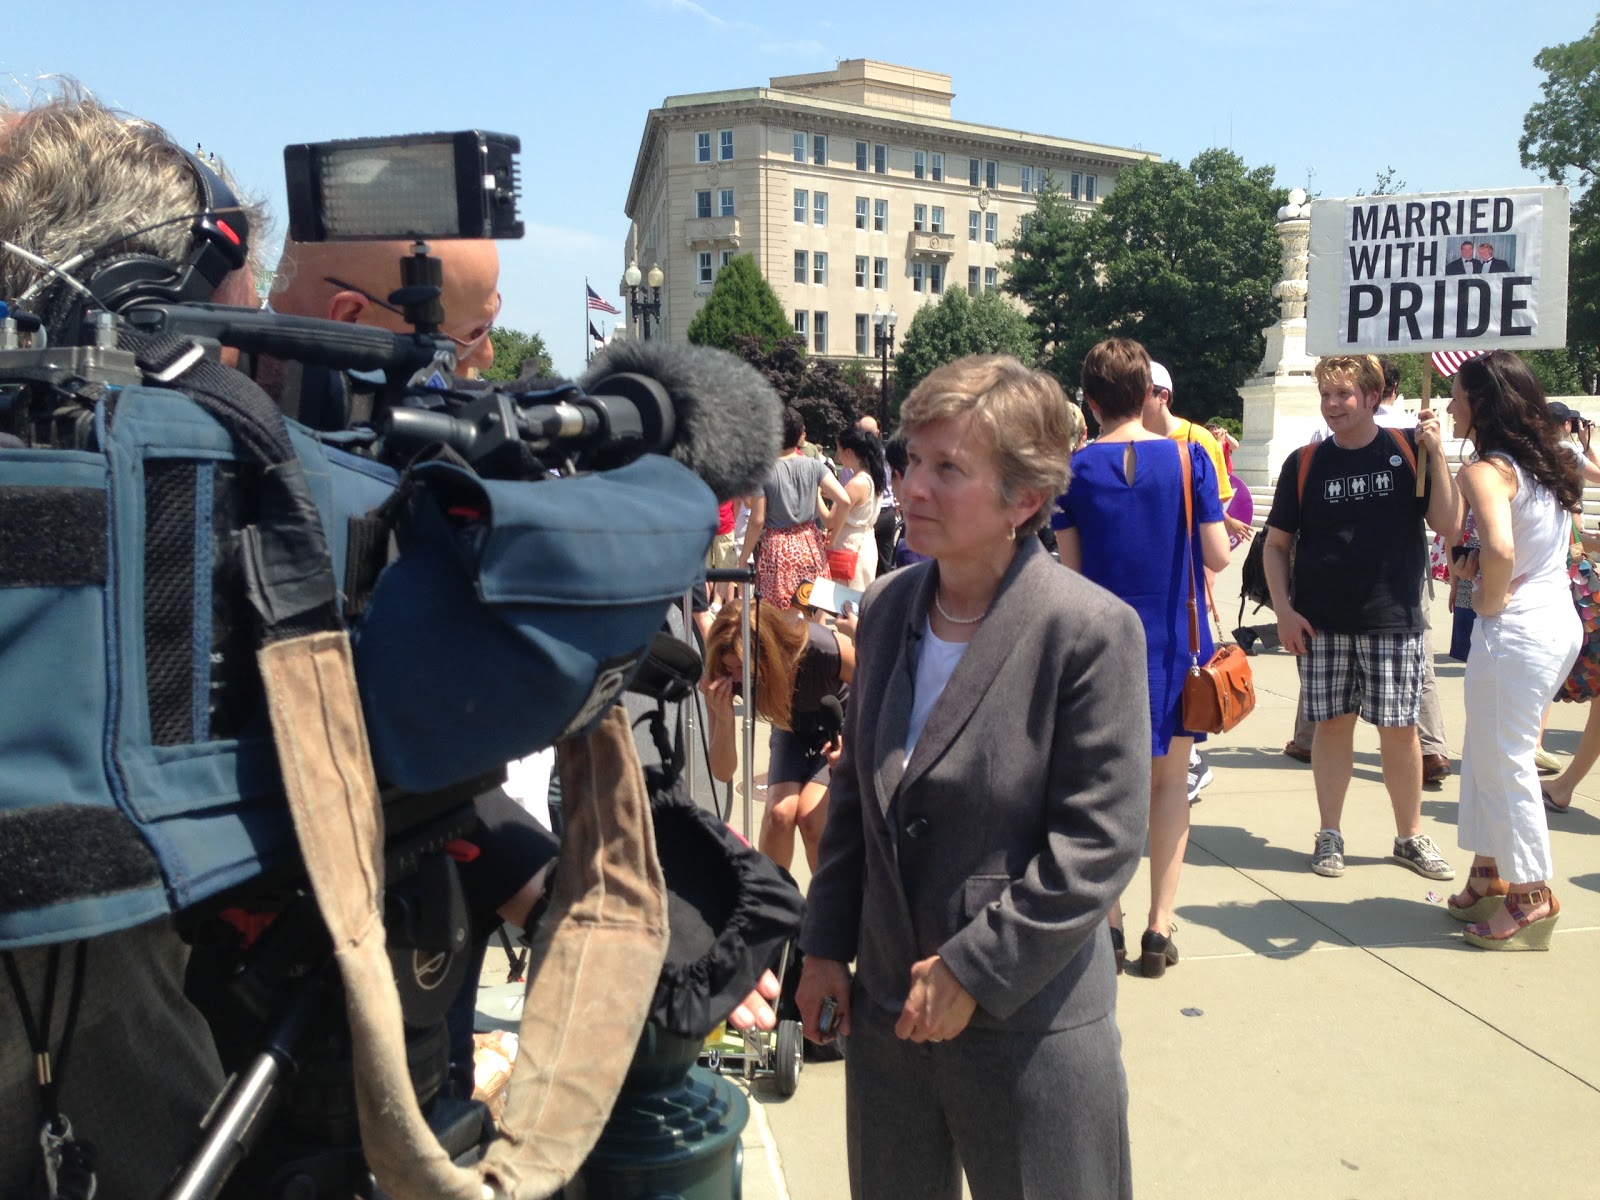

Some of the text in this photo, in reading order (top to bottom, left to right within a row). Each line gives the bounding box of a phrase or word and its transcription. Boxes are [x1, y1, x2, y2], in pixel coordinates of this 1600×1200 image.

[1352, 197, 1513, 241] MARRIED
[1349, 241, 1438, 280] WITH
[1347, 276, 1533, 343] PRIDE
